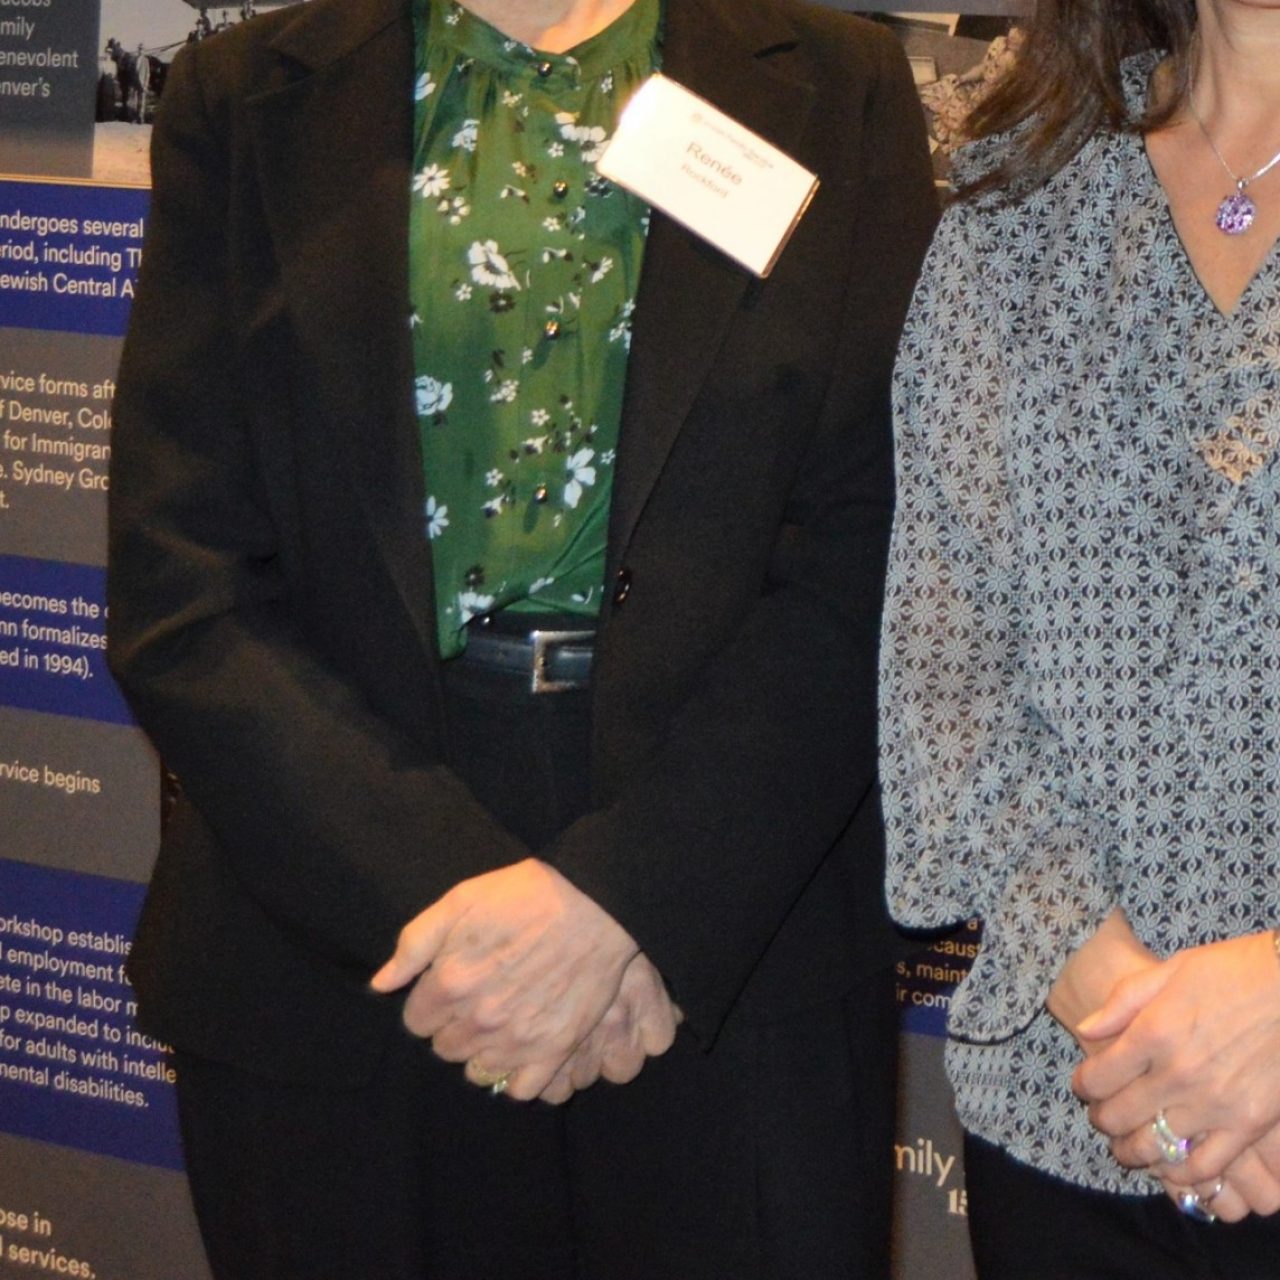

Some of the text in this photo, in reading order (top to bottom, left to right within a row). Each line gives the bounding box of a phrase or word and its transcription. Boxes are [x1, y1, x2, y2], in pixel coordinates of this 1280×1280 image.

[83, 217, 144, 238] several
[44, 241, 122, 272] including
[53, 272, 116, 297] Central
[40, 373, 88, 398] forms
[9, 401, 73, 429] Denver,
[3, 429, 28, 451] for
[13, 460, 75, 490] Sydney
[71, 596, 100, 619] the
[24, 647, 94, 680] in 1994).
[44, 765, 101, 794] begins
[7, 948, 114, 982] employment
[26, 976, 122, 1012] in the labor
[15, 1008, 121, 1043] expanded to
[25, 1037, 118, 1072] adults with
[54, 1071, 149, 1108] disabilities.
[33, 1211, 52, 1236] in
[9, 1243, 96, 1280] services.
